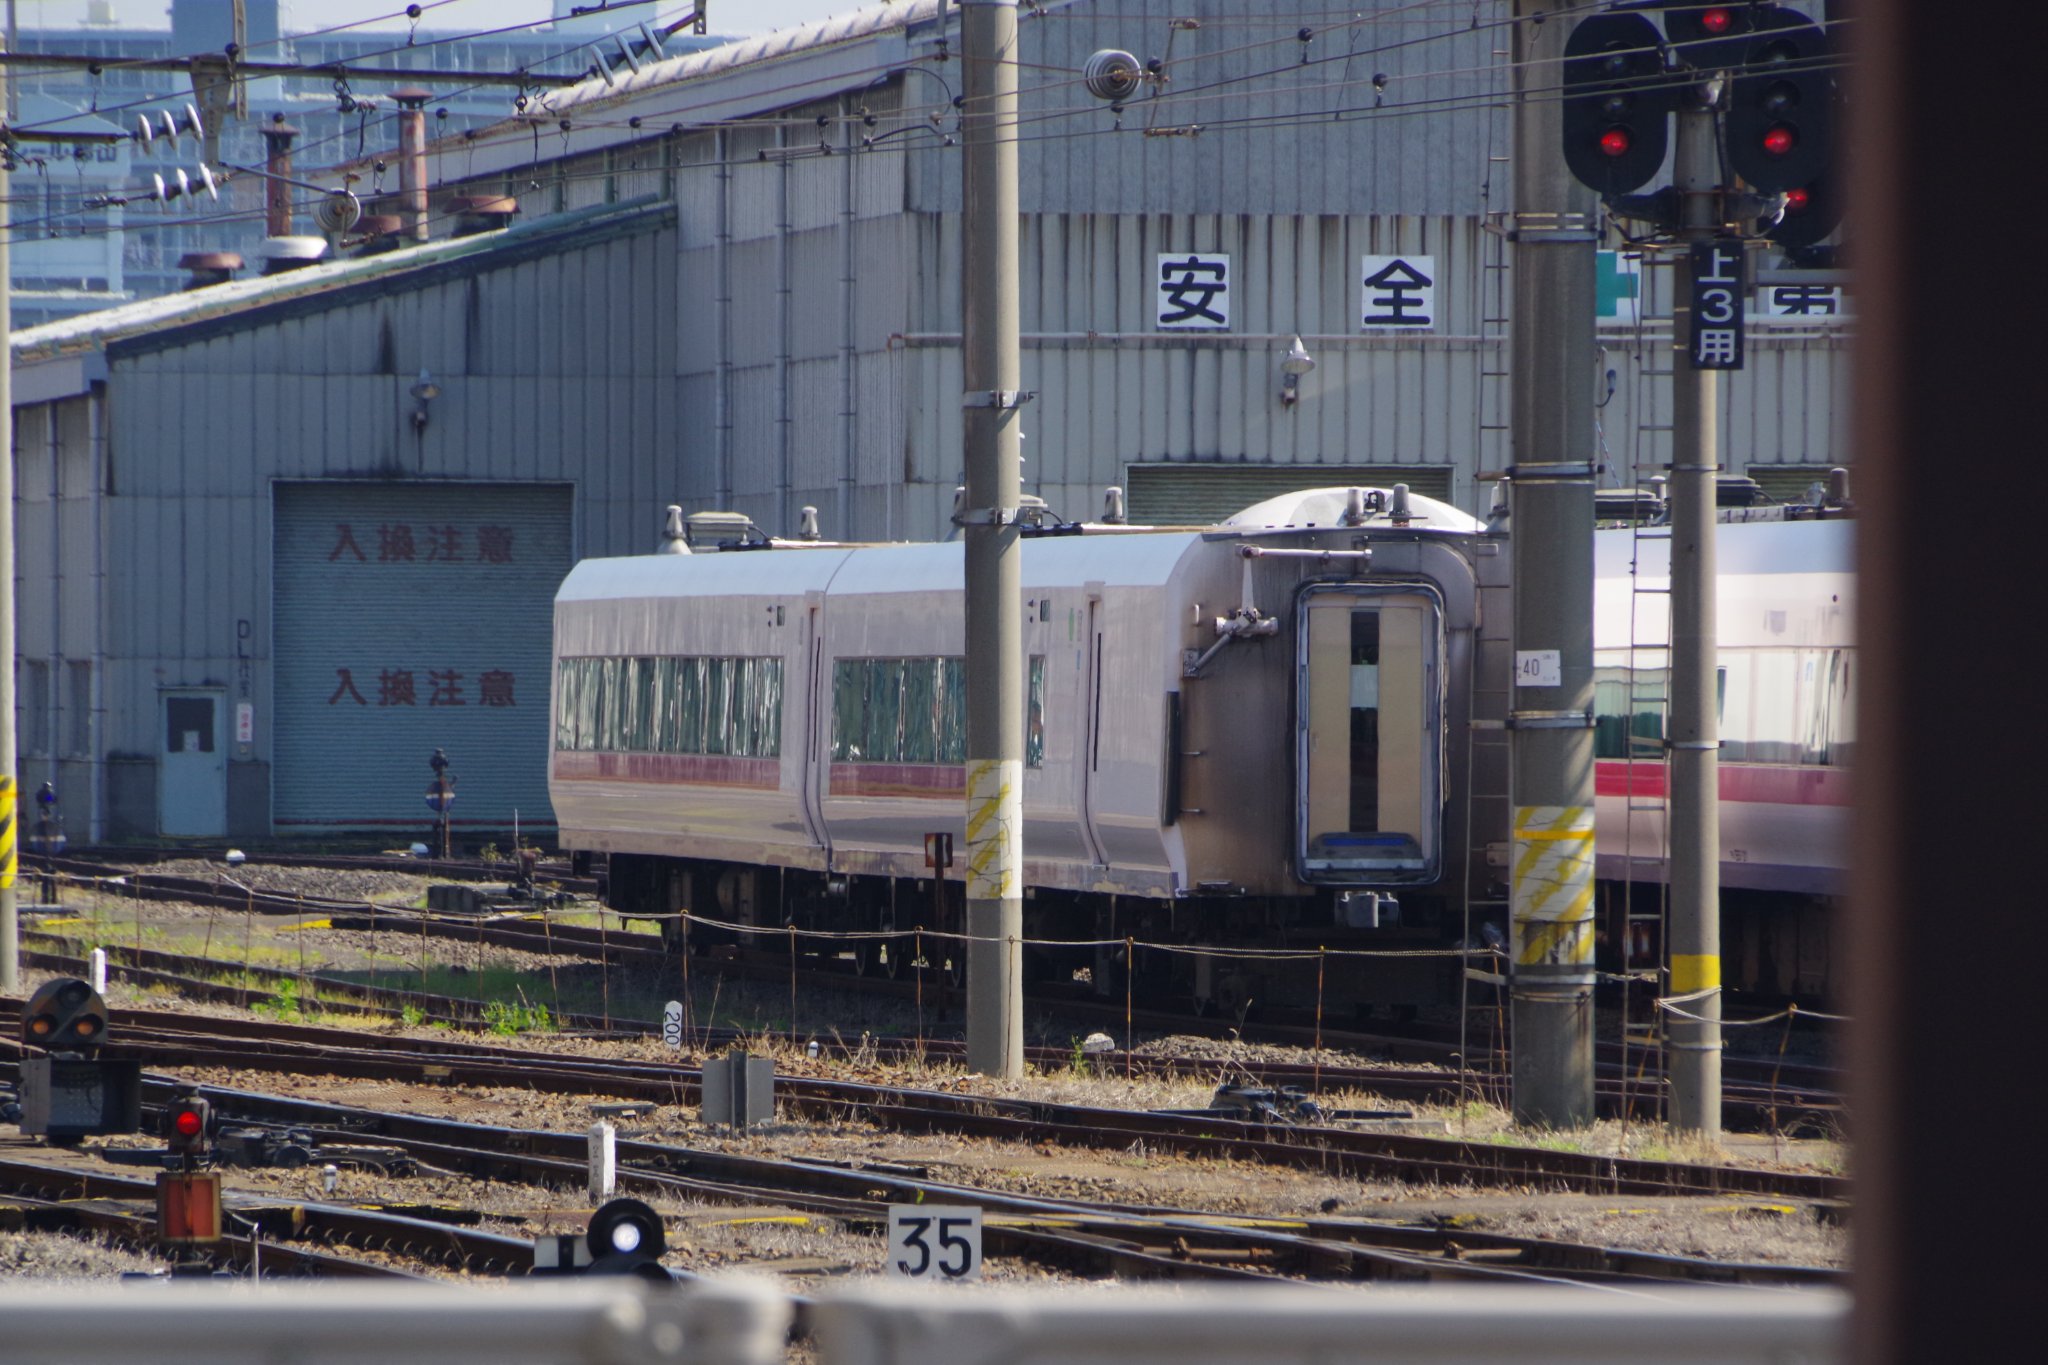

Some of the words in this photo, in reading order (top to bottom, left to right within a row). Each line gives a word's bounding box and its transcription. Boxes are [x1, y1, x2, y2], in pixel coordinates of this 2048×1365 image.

[1698, 248, 1737, 364] 上3用
[328, 523, 515, 563] 入換注意
[1523, 658, 1541, 677] 40
[328, 668, 517, 707] 入換注意
[664, 1011, 681, 1046] 200
[897, 1217, 973, 1278] 35
